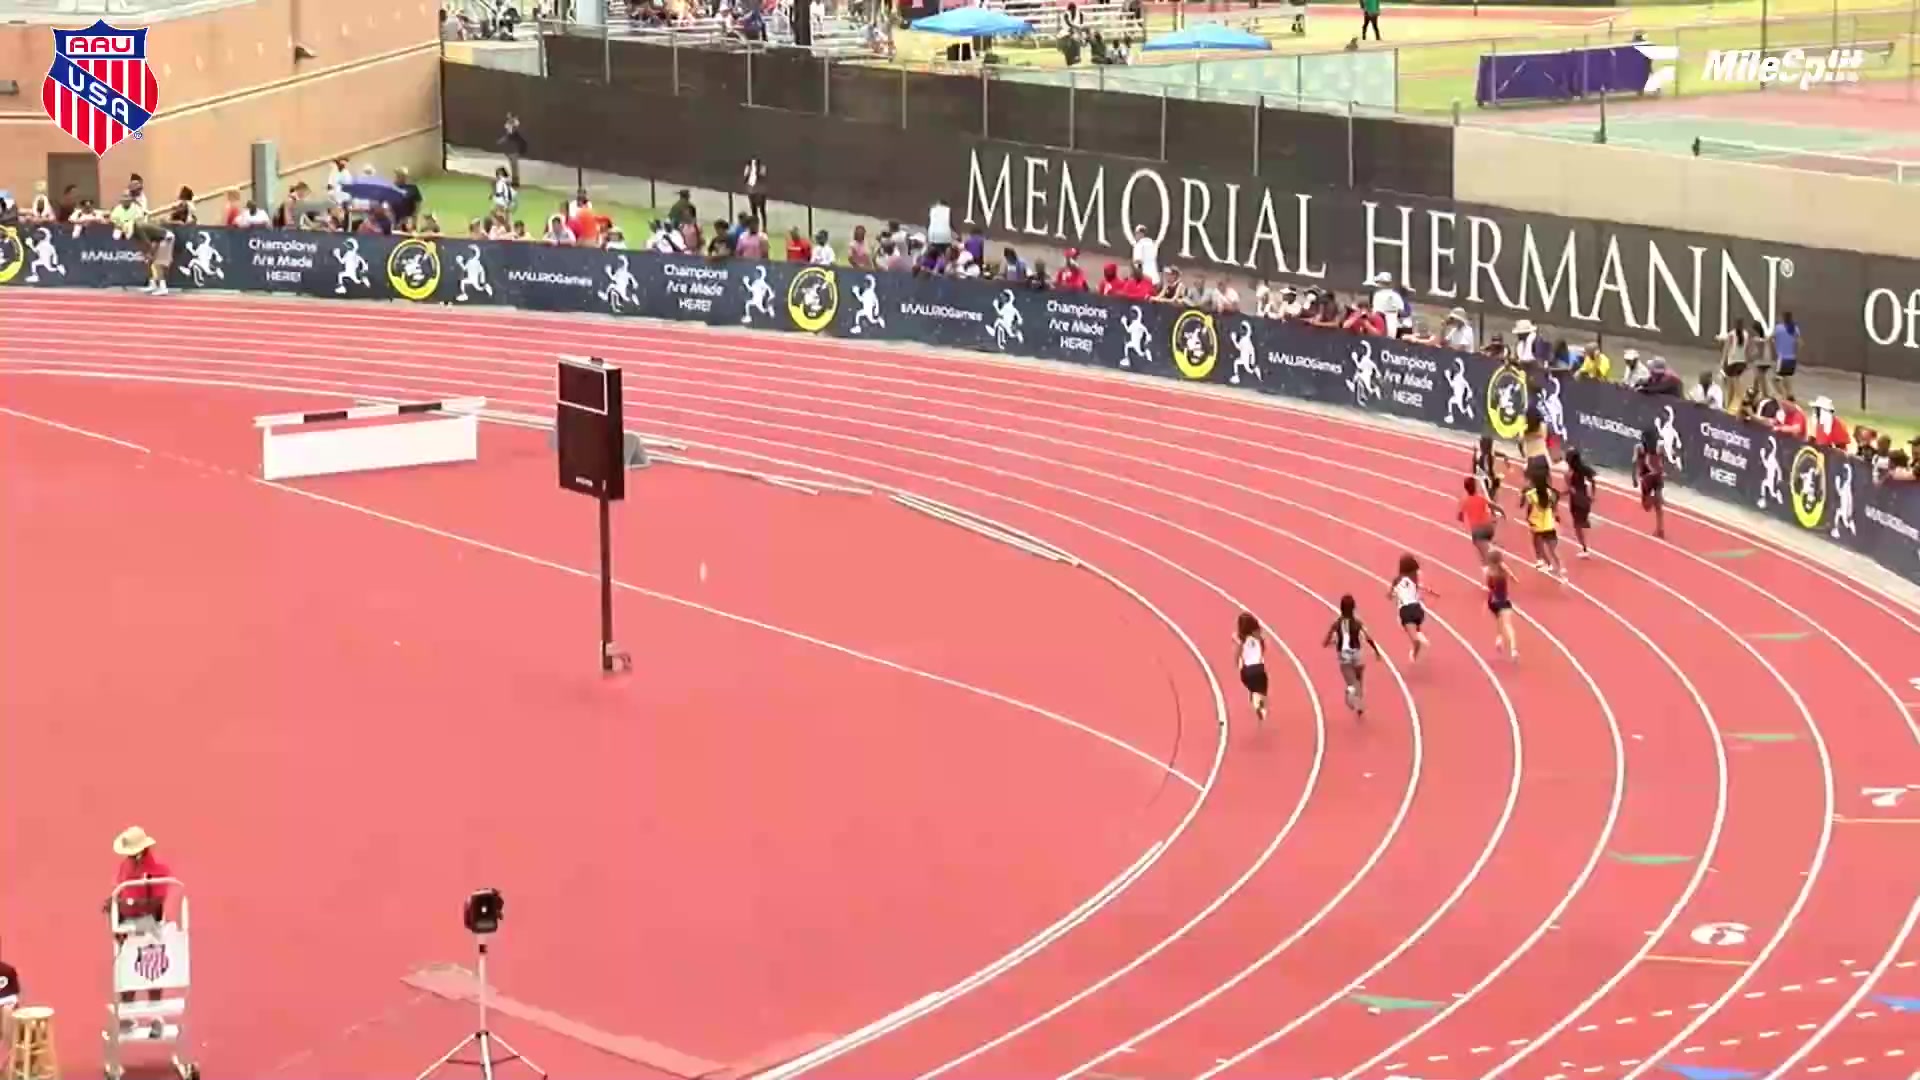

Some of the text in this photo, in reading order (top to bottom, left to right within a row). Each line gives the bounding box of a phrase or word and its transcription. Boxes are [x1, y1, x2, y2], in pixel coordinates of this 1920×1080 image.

[964, 147, 1327, 279] MEMORIAL
[249, 238, 317, 253] Champions
[252, 254, 313, 269] Are Made
[663, 264, 728, 281] Champions
[666, 280, 724, 297] Are Made
[1047, 300, 1108, 320] Champions
[1049, 319, 1104, 337] Are Made
[1060, 337, 1093, 352] HERE!
[1380, 350, 1437, 373] Champions
[1384, 369, 1433, 391] Are Made
[1393, 389, 1423, 408] HERE!
[1861, 787, 1908, 807] 7
